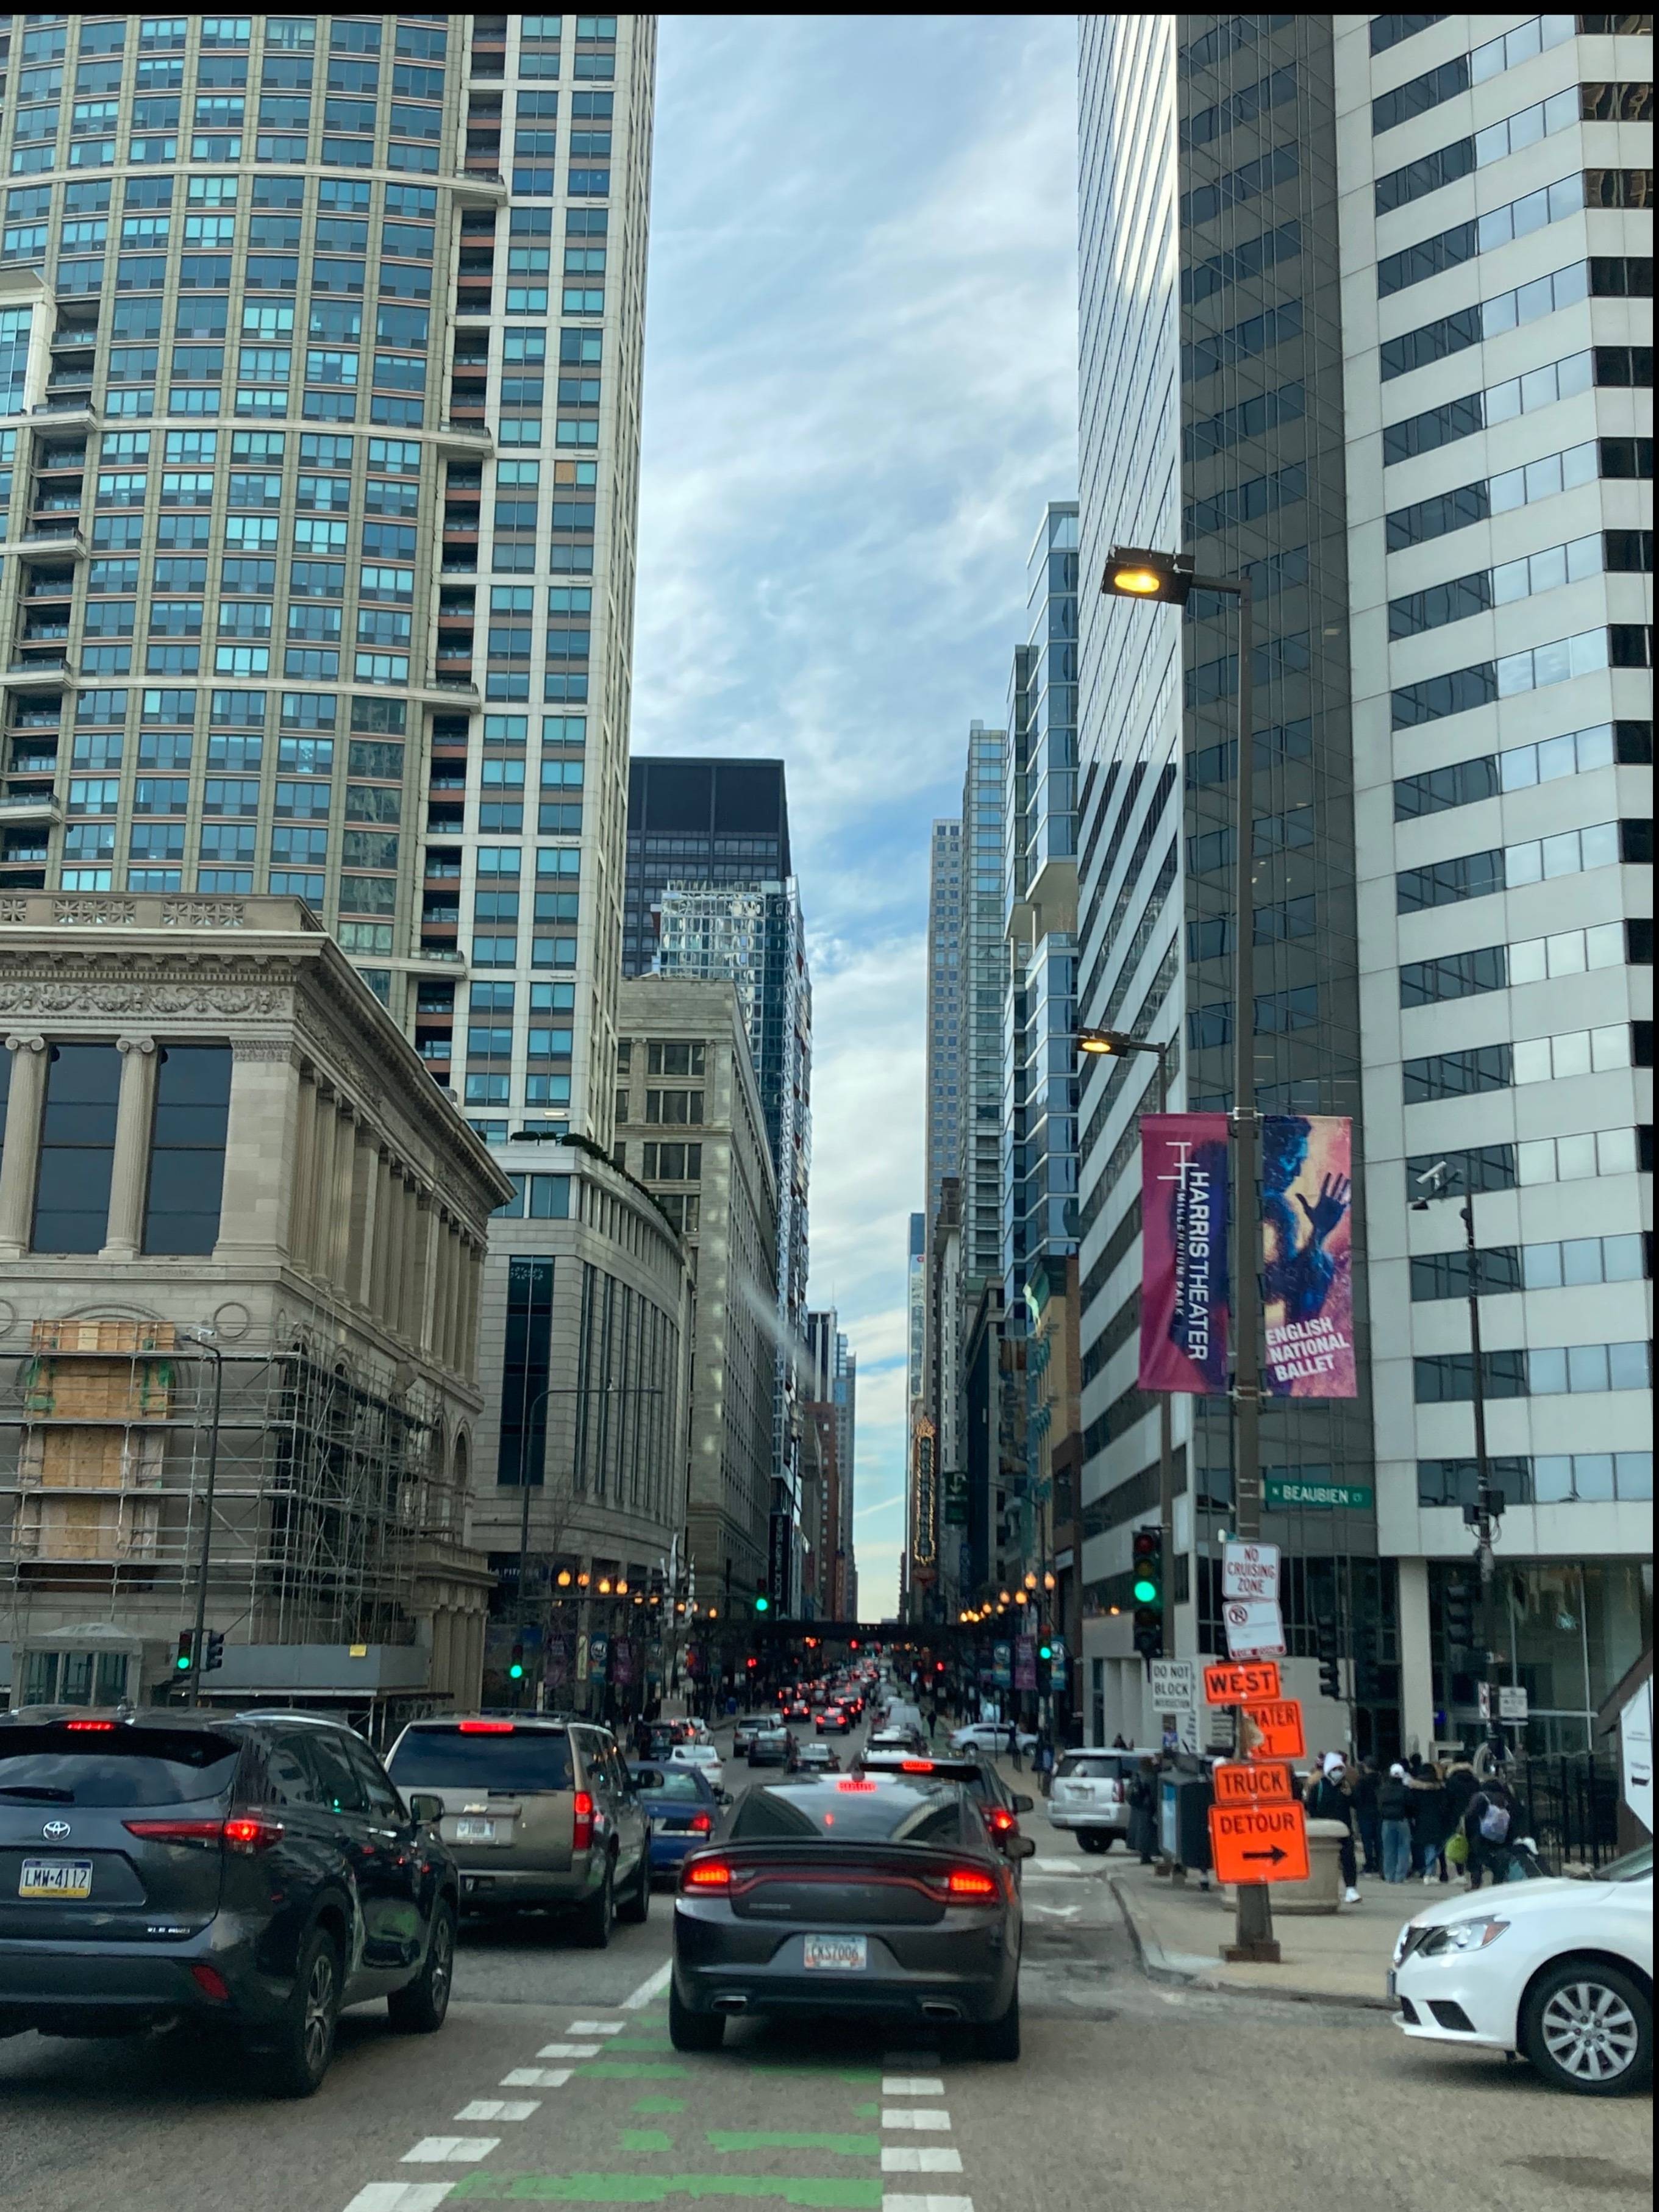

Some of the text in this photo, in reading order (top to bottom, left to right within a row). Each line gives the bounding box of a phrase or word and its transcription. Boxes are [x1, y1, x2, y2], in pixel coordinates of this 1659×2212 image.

[1175, 1192, 1186, 1316] MILLENNIUM PARK
[1188, 1172, 1210, 1360] HARRIS THEATER
[1265, 1317, 1333, 1344] ENGLISH
[1269, 1333, 1349, 1363] NATIONAL
[1274, 1357, 1335, 1382] BALLET
[1282, 1485, 1349, 1504] BEAUBIEN
[1244, 1548, 1259, 1561] NO
[1227, 1561, 1275, 1579] CRUISING
[1237, 1578, 1265, 1594] ZONE
[1154, 1665, 1189, 1678] DO NOT
[1210, 1671, 1272, 1694] WEST
[1154, 1682, 1189, 1696] BLOCK
[1222, 1771, 1283, 1795] TRUCK
[1220, 1813, 1295, 1835] DETOUR
